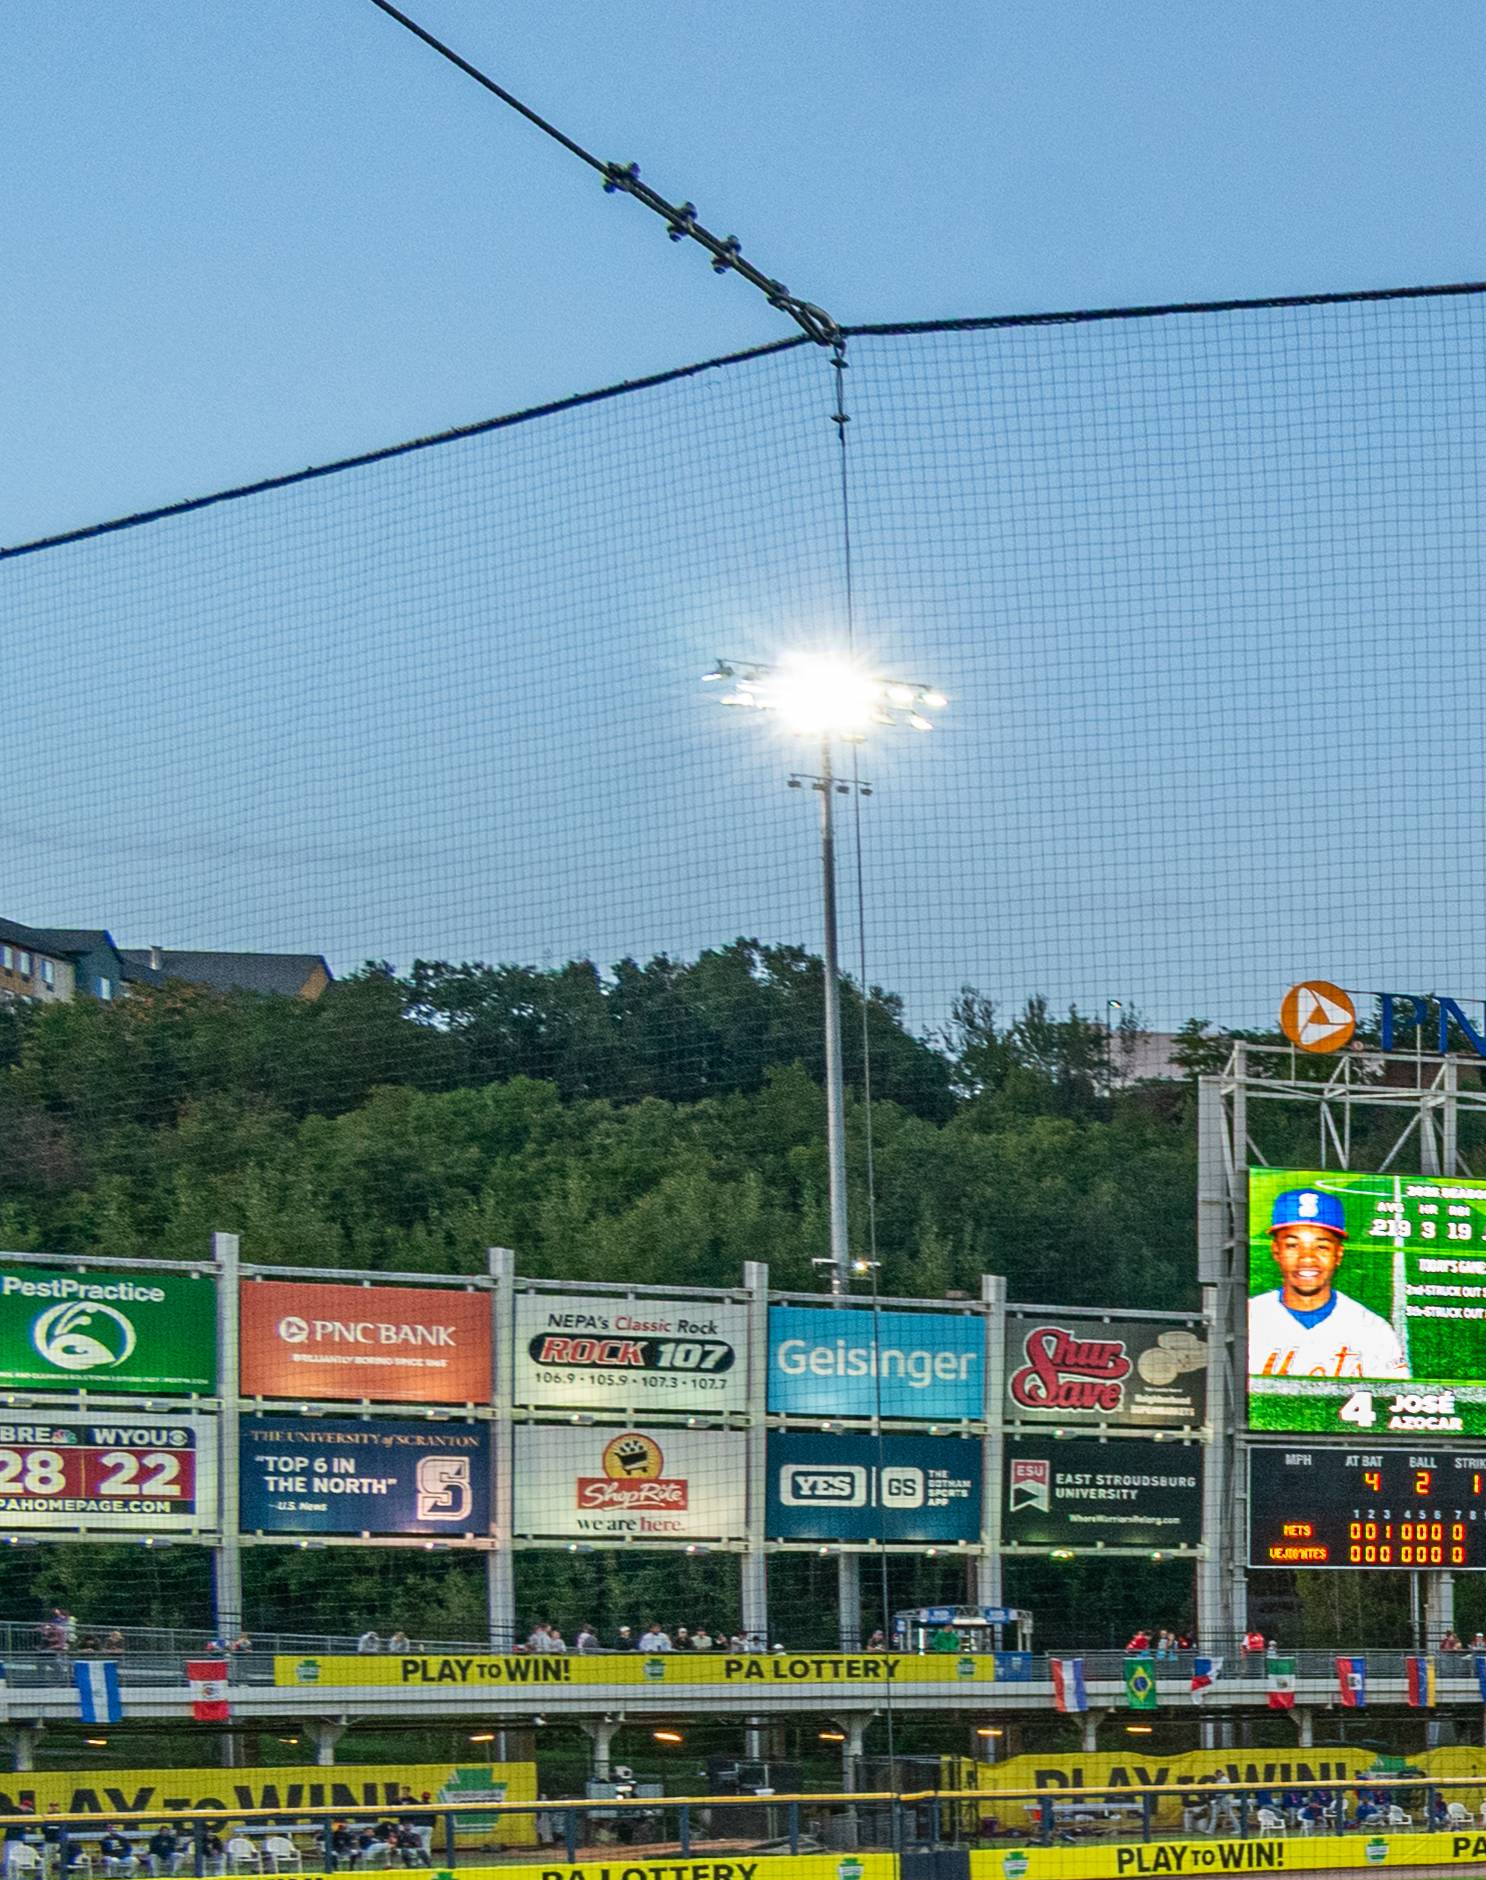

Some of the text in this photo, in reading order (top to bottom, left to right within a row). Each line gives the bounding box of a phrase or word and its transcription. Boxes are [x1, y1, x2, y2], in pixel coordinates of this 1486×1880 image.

[1369, 1219, 1411, 1237] .219
[1421, 1221, 1436, 1239] 3
[1447, 1222, 1472, 1240] 19
[2, 1276, 166, 1302] PestPractice
[313, 1320, 456, 1346] PNC BANK
[548, 1314, 718, 1336] NEPA's Classic Rock
[538, 1337, 729, 1370] ROCK 107
[778, 1339, 977, 1388] Geisinger
[535, 1372, 728, 1390] 106.9 105.9 107.3 107.7
[1340, 1390, 1456, 1427] 4 JOSÉ
[1388, 1416, 1463, 1430] AZOCAR
[93, 1428, 168, 1446] WYOU
[251, 1431, 284, 1443] THE
[287, 1431, 382, 1446] UNIVERSITY
[393, 1435, 480, 1448] SCRANTON
[314, 1457, 356, 1474] 6 IN
[1016, 1465, 1044, 1477] ESU
[1285, 1454, 1312, 1466] MPH
[1345, 1455, 1359, 1467] AT
[1362, 1455, 1384, 1468] BAT
[1409, 1456, 1437, 1468] BALL
[0, 1450, 181, 1496] 28 22
[1055, 1473, 1196, 1488] EAST STROUDSBURG
[1364, 1472, 1381, 1492] 4
[1415, 1472, 1432, 1495] 2
[1473, 1473, 1482, 1495] 1
[264, 1476, 307, 1493] THE
[795, 1476, 852, 1497] YES
[888, 1478, 916, 1497] GS
[1055, 1488, 1138, 1500] UNIVERSITY
[581, 1482, 683, 1511] ShopRite
[927, 1498, 948, 1508] APP
[577, 1516, 685, 1532] we are here.
[401, 1658, 901, 1682] PLAY TO WIN! PA LOTTERY
[1115, 1844, 1188, 1874] PLAY
[1191, 1848, 1216, 1867] TO
[1217, 1841, 1285, 1870] WIN!
